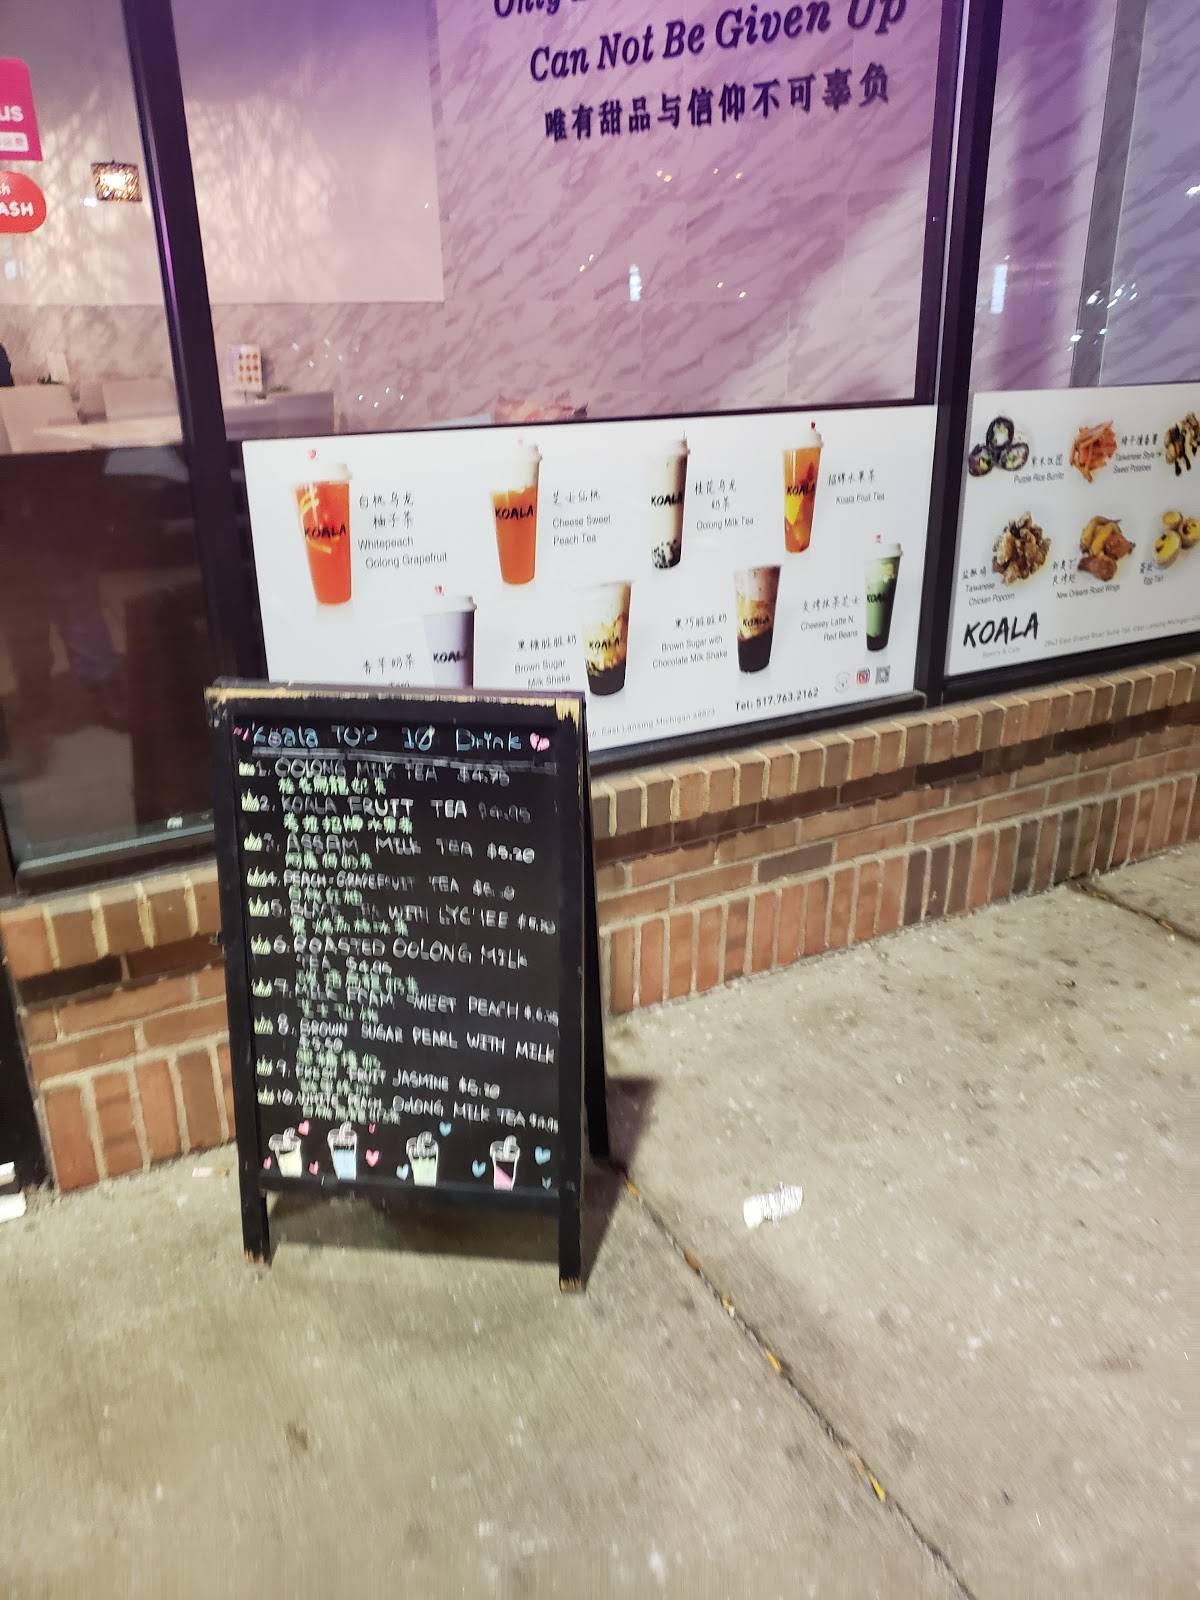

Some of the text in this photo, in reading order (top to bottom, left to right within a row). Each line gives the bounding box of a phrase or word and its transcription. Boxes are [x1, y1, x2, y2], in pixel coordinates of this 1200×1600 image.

[530, 0, 905, 82] Can Not Be Given Up
[545, 62, 890, 143] 唯有甜品与信仰不可辜负
[494, 505, 535, 520] KOALA
[552, 514, 611, 529] Cheese Sweet
[741, 515, 754, 527] Tea
[304, 524, 347, 539] KOALA
[553, 533, 597, 547] Peach Tea
[358, 536, 414, 551] Whitepeach
[365, 551, 448, 570] Oolong Grapefruit
[968, 595, 992, 606] Chicken
[962, 612, 1039, 648] KOALA
[661, 641, 685, 652] Brown
[687, 638, 706, 649] Sugar
[514, 658, 566, 674] Brown Sugar
[653, 650, 728, 670] Chocolate Milk Shake
[527, 674, 571, 690] Milk Shake
[275, 757, 347, 779] OOLONG
[405, 762, 438, 783] TEA
[281, 795, 337, 815] KOALA
[347, 796, 414, 818] FRUIT
[431, 799, 467, 819] TEA
[286, 833, 359, 854] ASSAM
[376, 834, 421, 856] MILK
[436, 838, 473, 858] TEA
[429, 875, 460, 894] TEA
[389, 903, 429, 924] WITH
[294, 934, 386, 957] ROASTED
[393, 937, 472, 964] OOLONG
[481, 944, 528, 970] MILK
[296, 953, 331, 970] TEA
[468, 995, 519, 1021] PEACH
[300, 1017, 348, 1037] BROWN
[361, 1021, 404, 1043] SUGAR
[412, 1026, 457, 1049] PEARL
[467, 1031, 505, 1055] WITH
[516, 1041, 555, 1064] MILK
[392, 1068, 449, 1092] JASMINE
[392, 1096, 444, 1117] OOLONG
[454, 1101, 490, 1123] MILK
[497, 1107, 526, 1128] TEA
